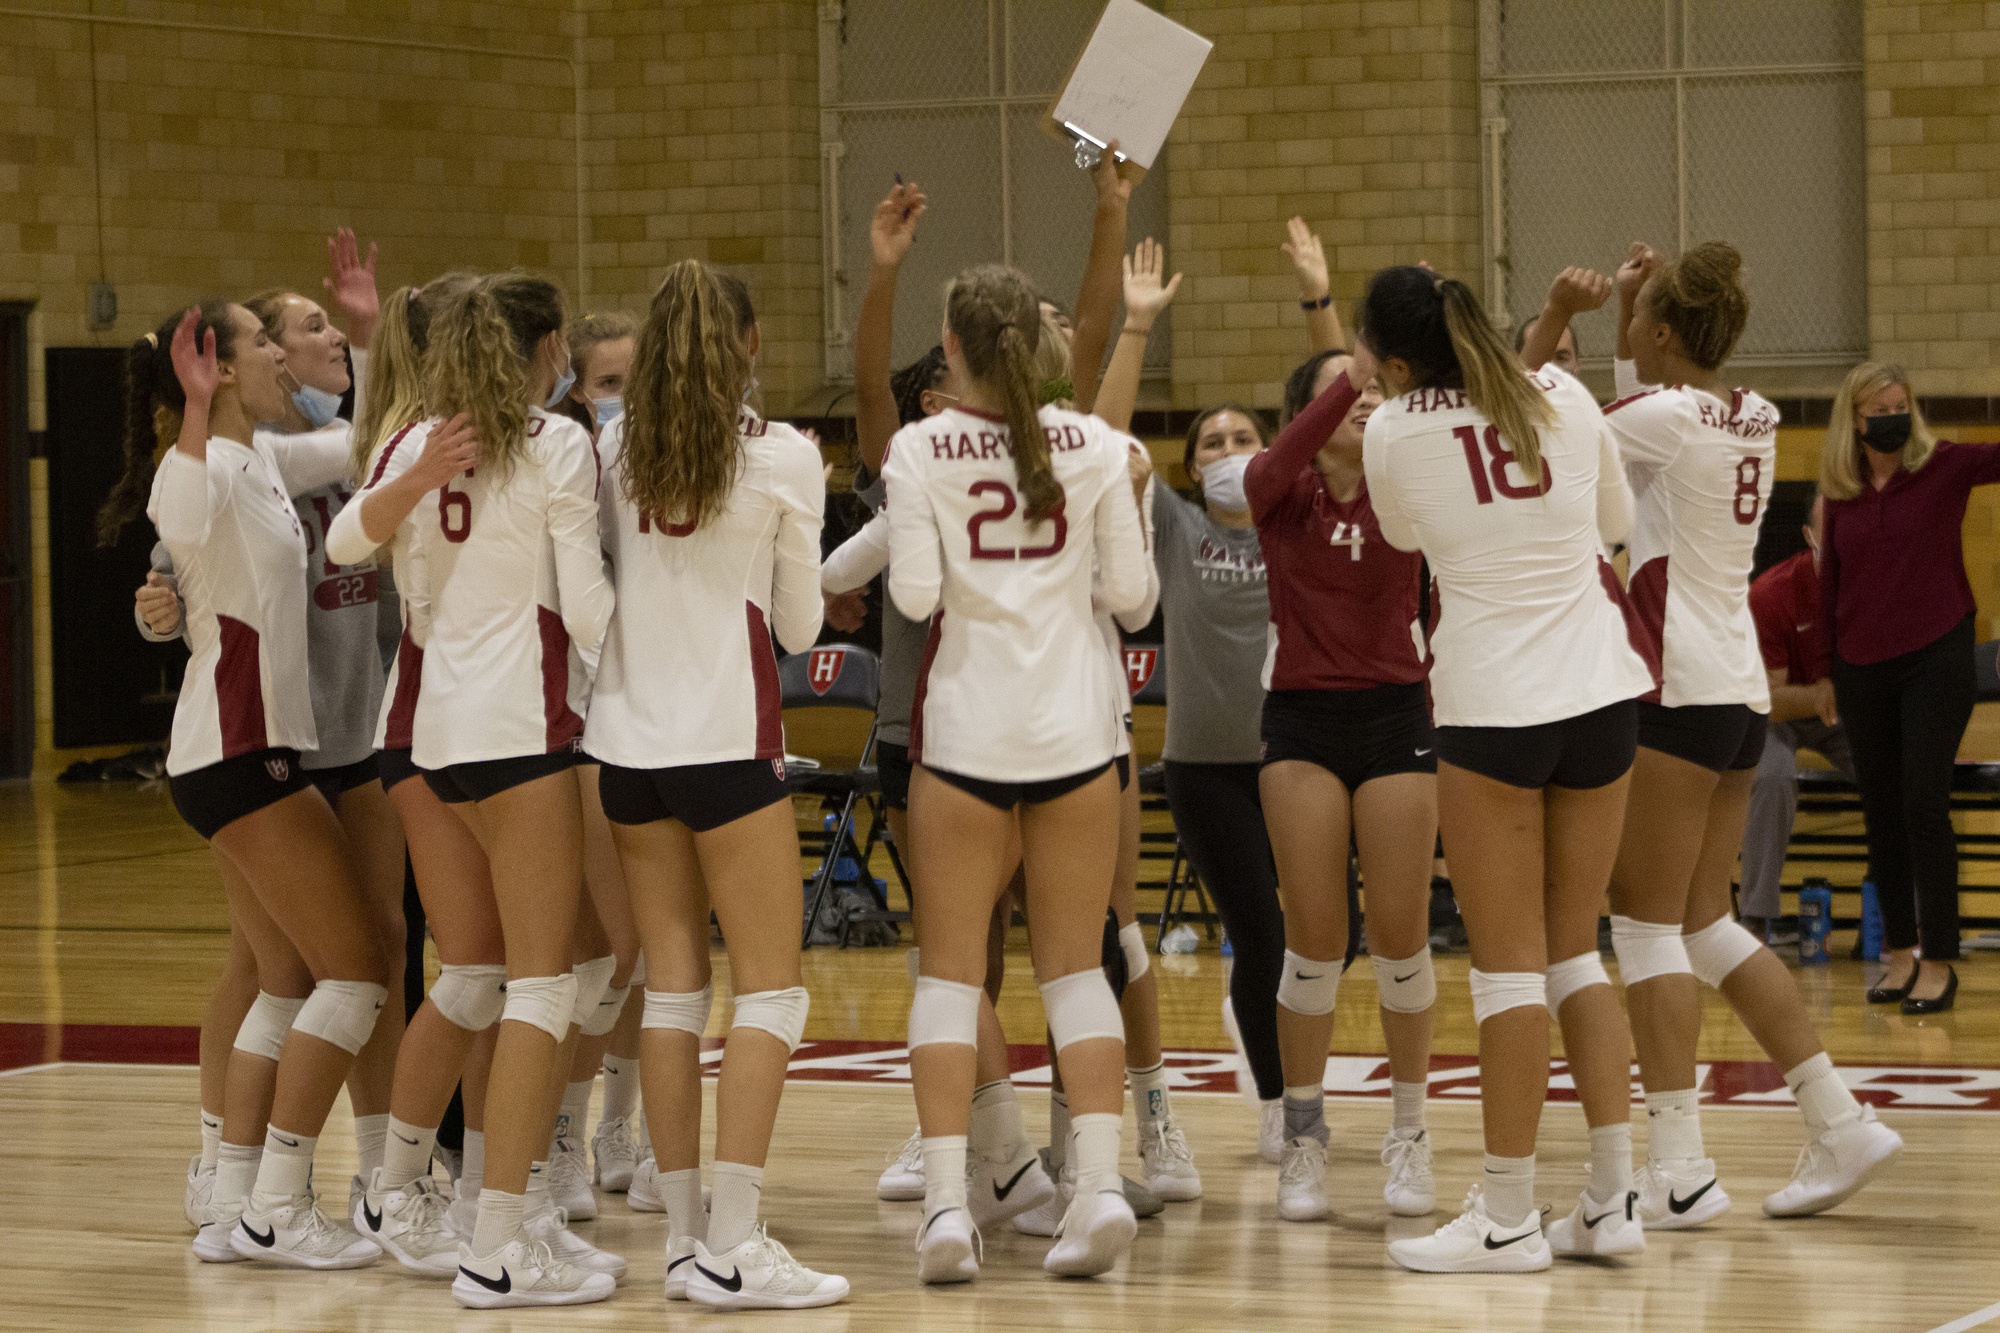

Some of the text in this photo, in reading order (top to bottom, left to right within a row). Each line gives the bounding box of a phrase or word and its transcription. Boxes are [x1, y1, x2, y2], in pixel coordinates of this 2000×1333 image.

[1452, 423, 1553, 505] 18
[1733, 456, 1761, 526] 8
[967, 480, 1068, 561] 23
[1330, 521, 1365, 561] 4
[337, 576, 368, 606] 22
[814, 653, 837, 682] H
[1127, 653, 1148, 682] H
